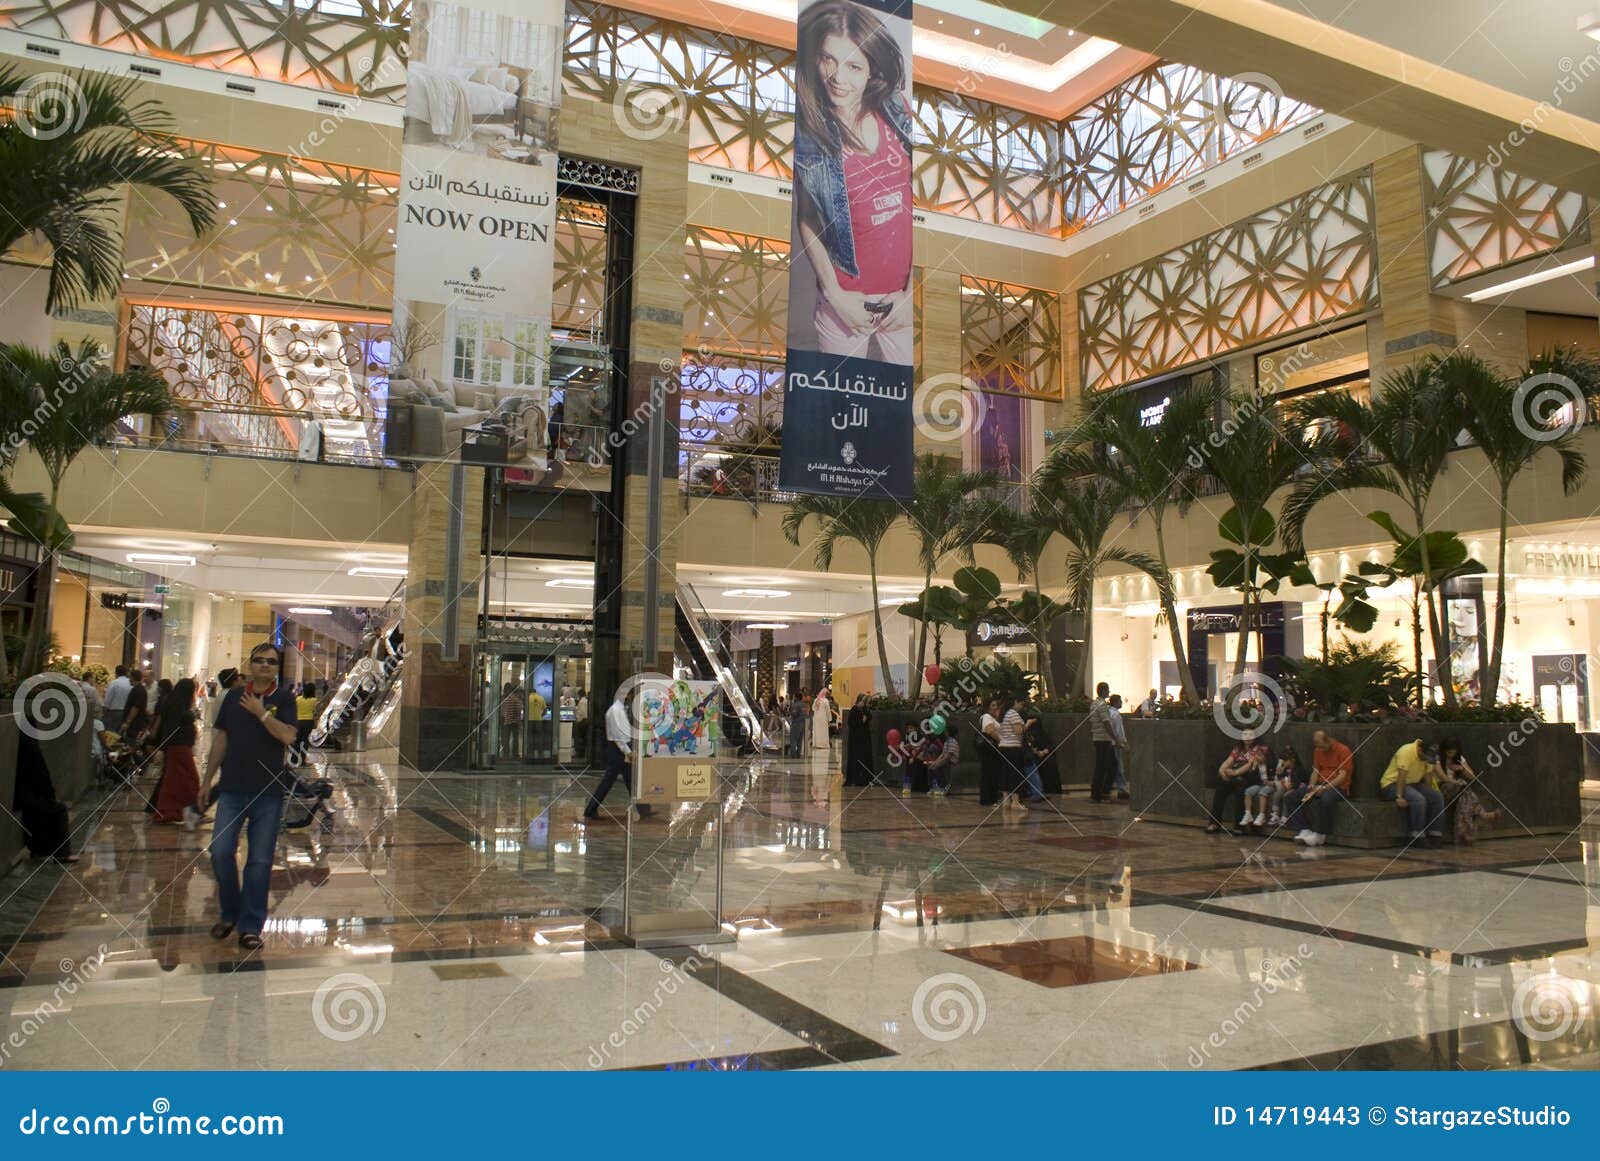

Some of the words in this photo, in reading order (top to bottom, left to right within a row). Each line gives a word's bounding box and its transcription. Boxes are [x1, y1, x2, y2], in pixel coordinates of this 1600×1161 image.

[408, 169, 443, 191] الآن
[446, 179, 550, 207] نستقبلكم
[405, 204, 474, 232] NOW
[479, 215, 550, 243] OPEN
[788, 369, 907, 401] نستقبلكم
[831, 403, 868, 430] الآن
